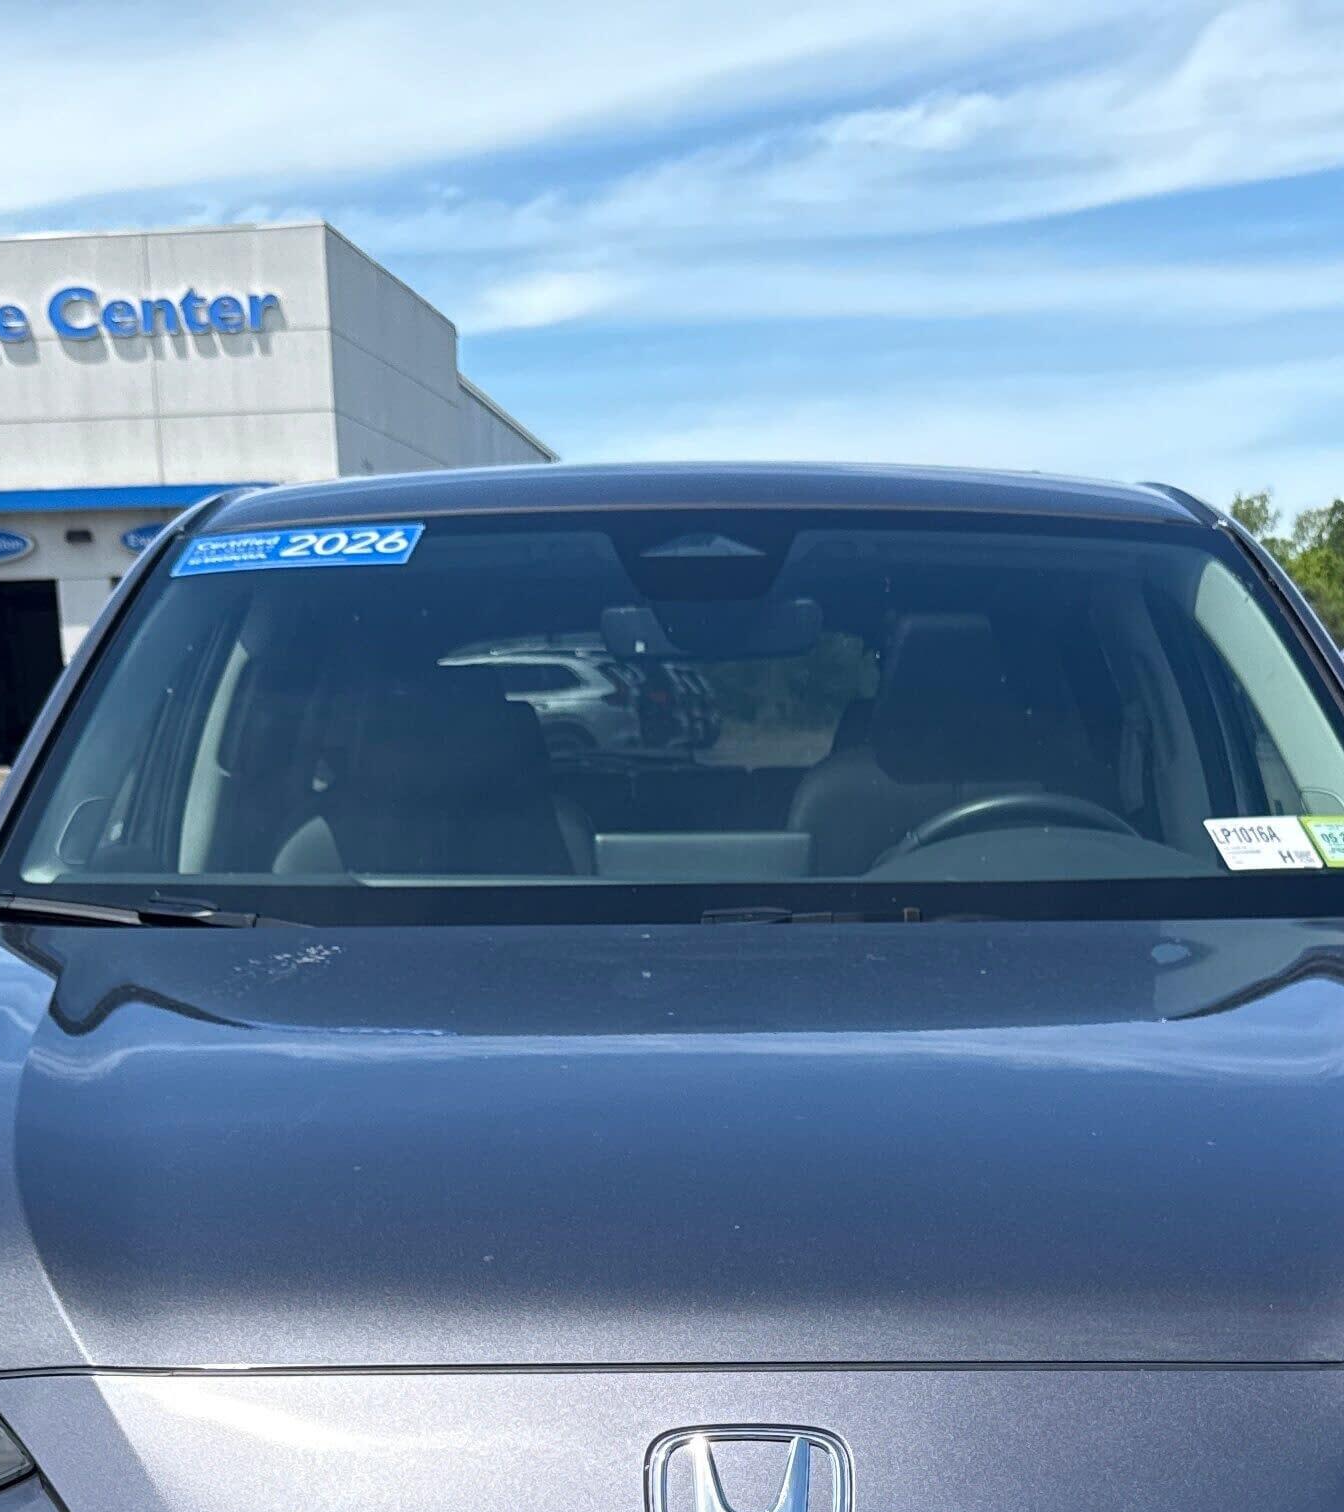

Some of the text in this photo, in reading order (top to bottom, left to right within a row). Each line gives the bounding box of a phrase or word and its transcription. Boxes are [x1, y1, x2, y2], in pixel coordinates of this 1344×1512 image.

[47, 286, 282, 340] Center
[280, 530, 409, 557] 2026
[1212, 825, 1282, 845] LP1016A
